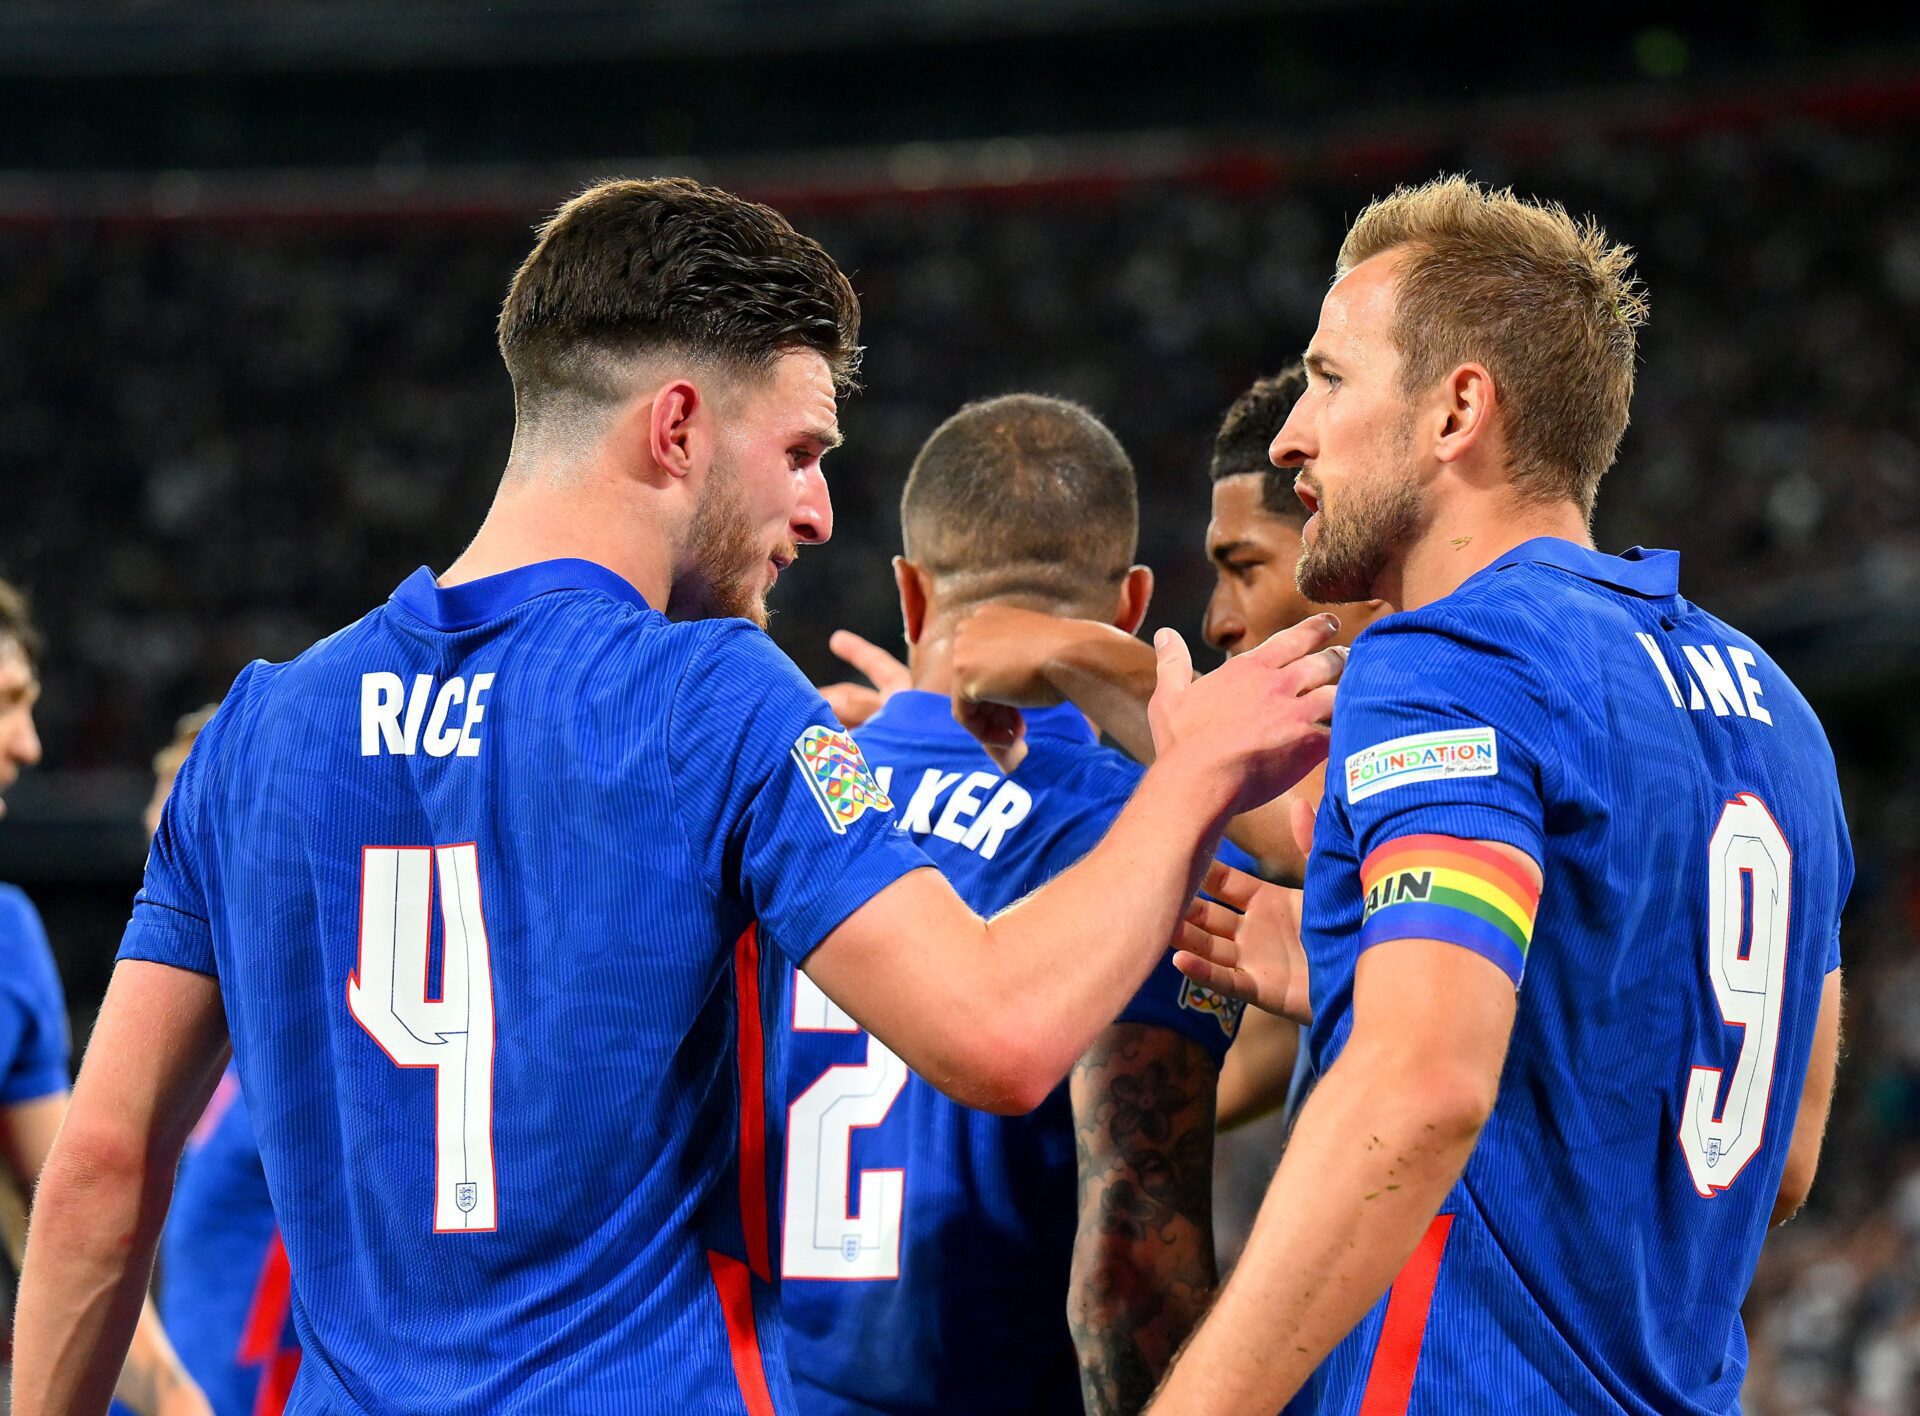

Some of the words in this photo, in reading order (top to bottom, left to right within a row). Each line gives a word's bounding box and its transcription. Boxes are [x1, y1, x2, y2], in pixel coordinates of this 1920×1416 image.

[361, 671, 496, 758] RICE
[346, 841, 498, 1234] 4
[1363, 871, 1432, 916] AIN
[1677, 792, 1793, 1198] 9
[780, 967, 909, 1280] 2
